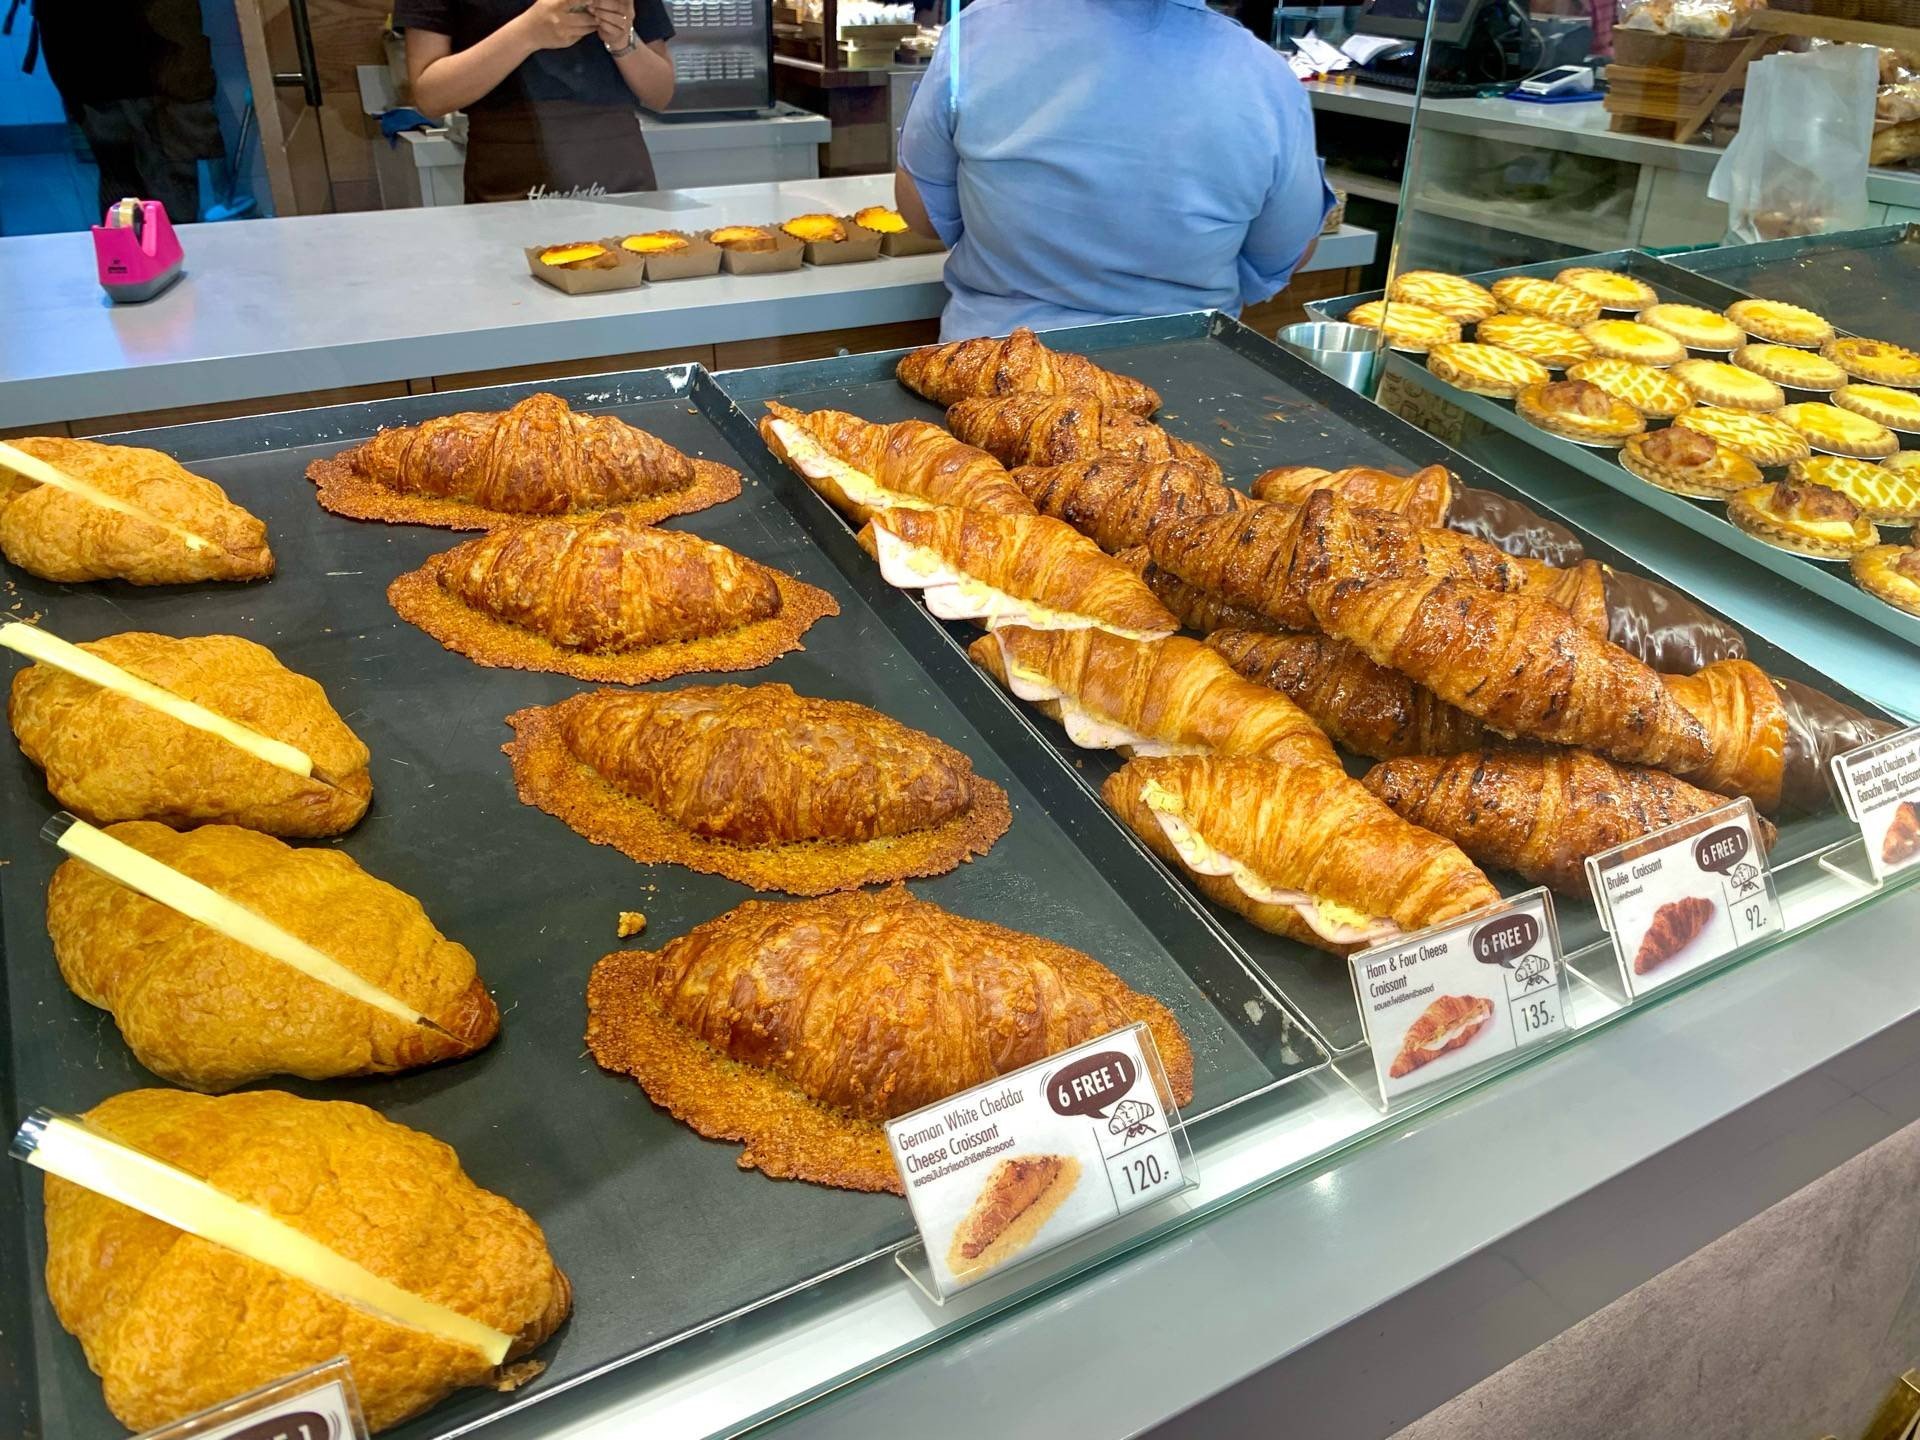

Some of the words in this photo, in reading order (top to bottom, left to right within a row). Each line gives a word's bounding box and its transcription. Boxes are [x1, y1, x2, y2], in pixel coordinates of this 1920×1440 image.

[1871, 762, 1885, 778] Dark
[1702, 848, 1710, 866] 6
[1710, 837, 1736, 862] FREE
[1736, 833, 1744, 850] 1
[1632, 858, 1663, 880] Croissant
[1481, 938, 1490, 956] 6
[1491, 926, 1522, 953] FREE
[1524, 922, 1532, 941] 1
[1366, 964, 1387, 980] Ham
[1389, 957, 1397, 972] &
[1398, 953, 1418, 969] Four
[1418, 943, 1448, 961] Cheese
[1370, 975, 1407, 998] Croissant
[1058, 1085, 1071, 1107] 6
[1071, 1066, 1115, 1102] FREE
[1114, 1061, 1127, 1082] 1
[898, 1123, 945, 1151] German
[944, 1108, 979, 1132] White
[979, 1088, 1025, 1117] Cheddar
[906, 1147, 948, 1174] Cheese
[949, 1123, 1000, 1156] Croissant
[1122, 1154, 1169, 1194] 120.-
